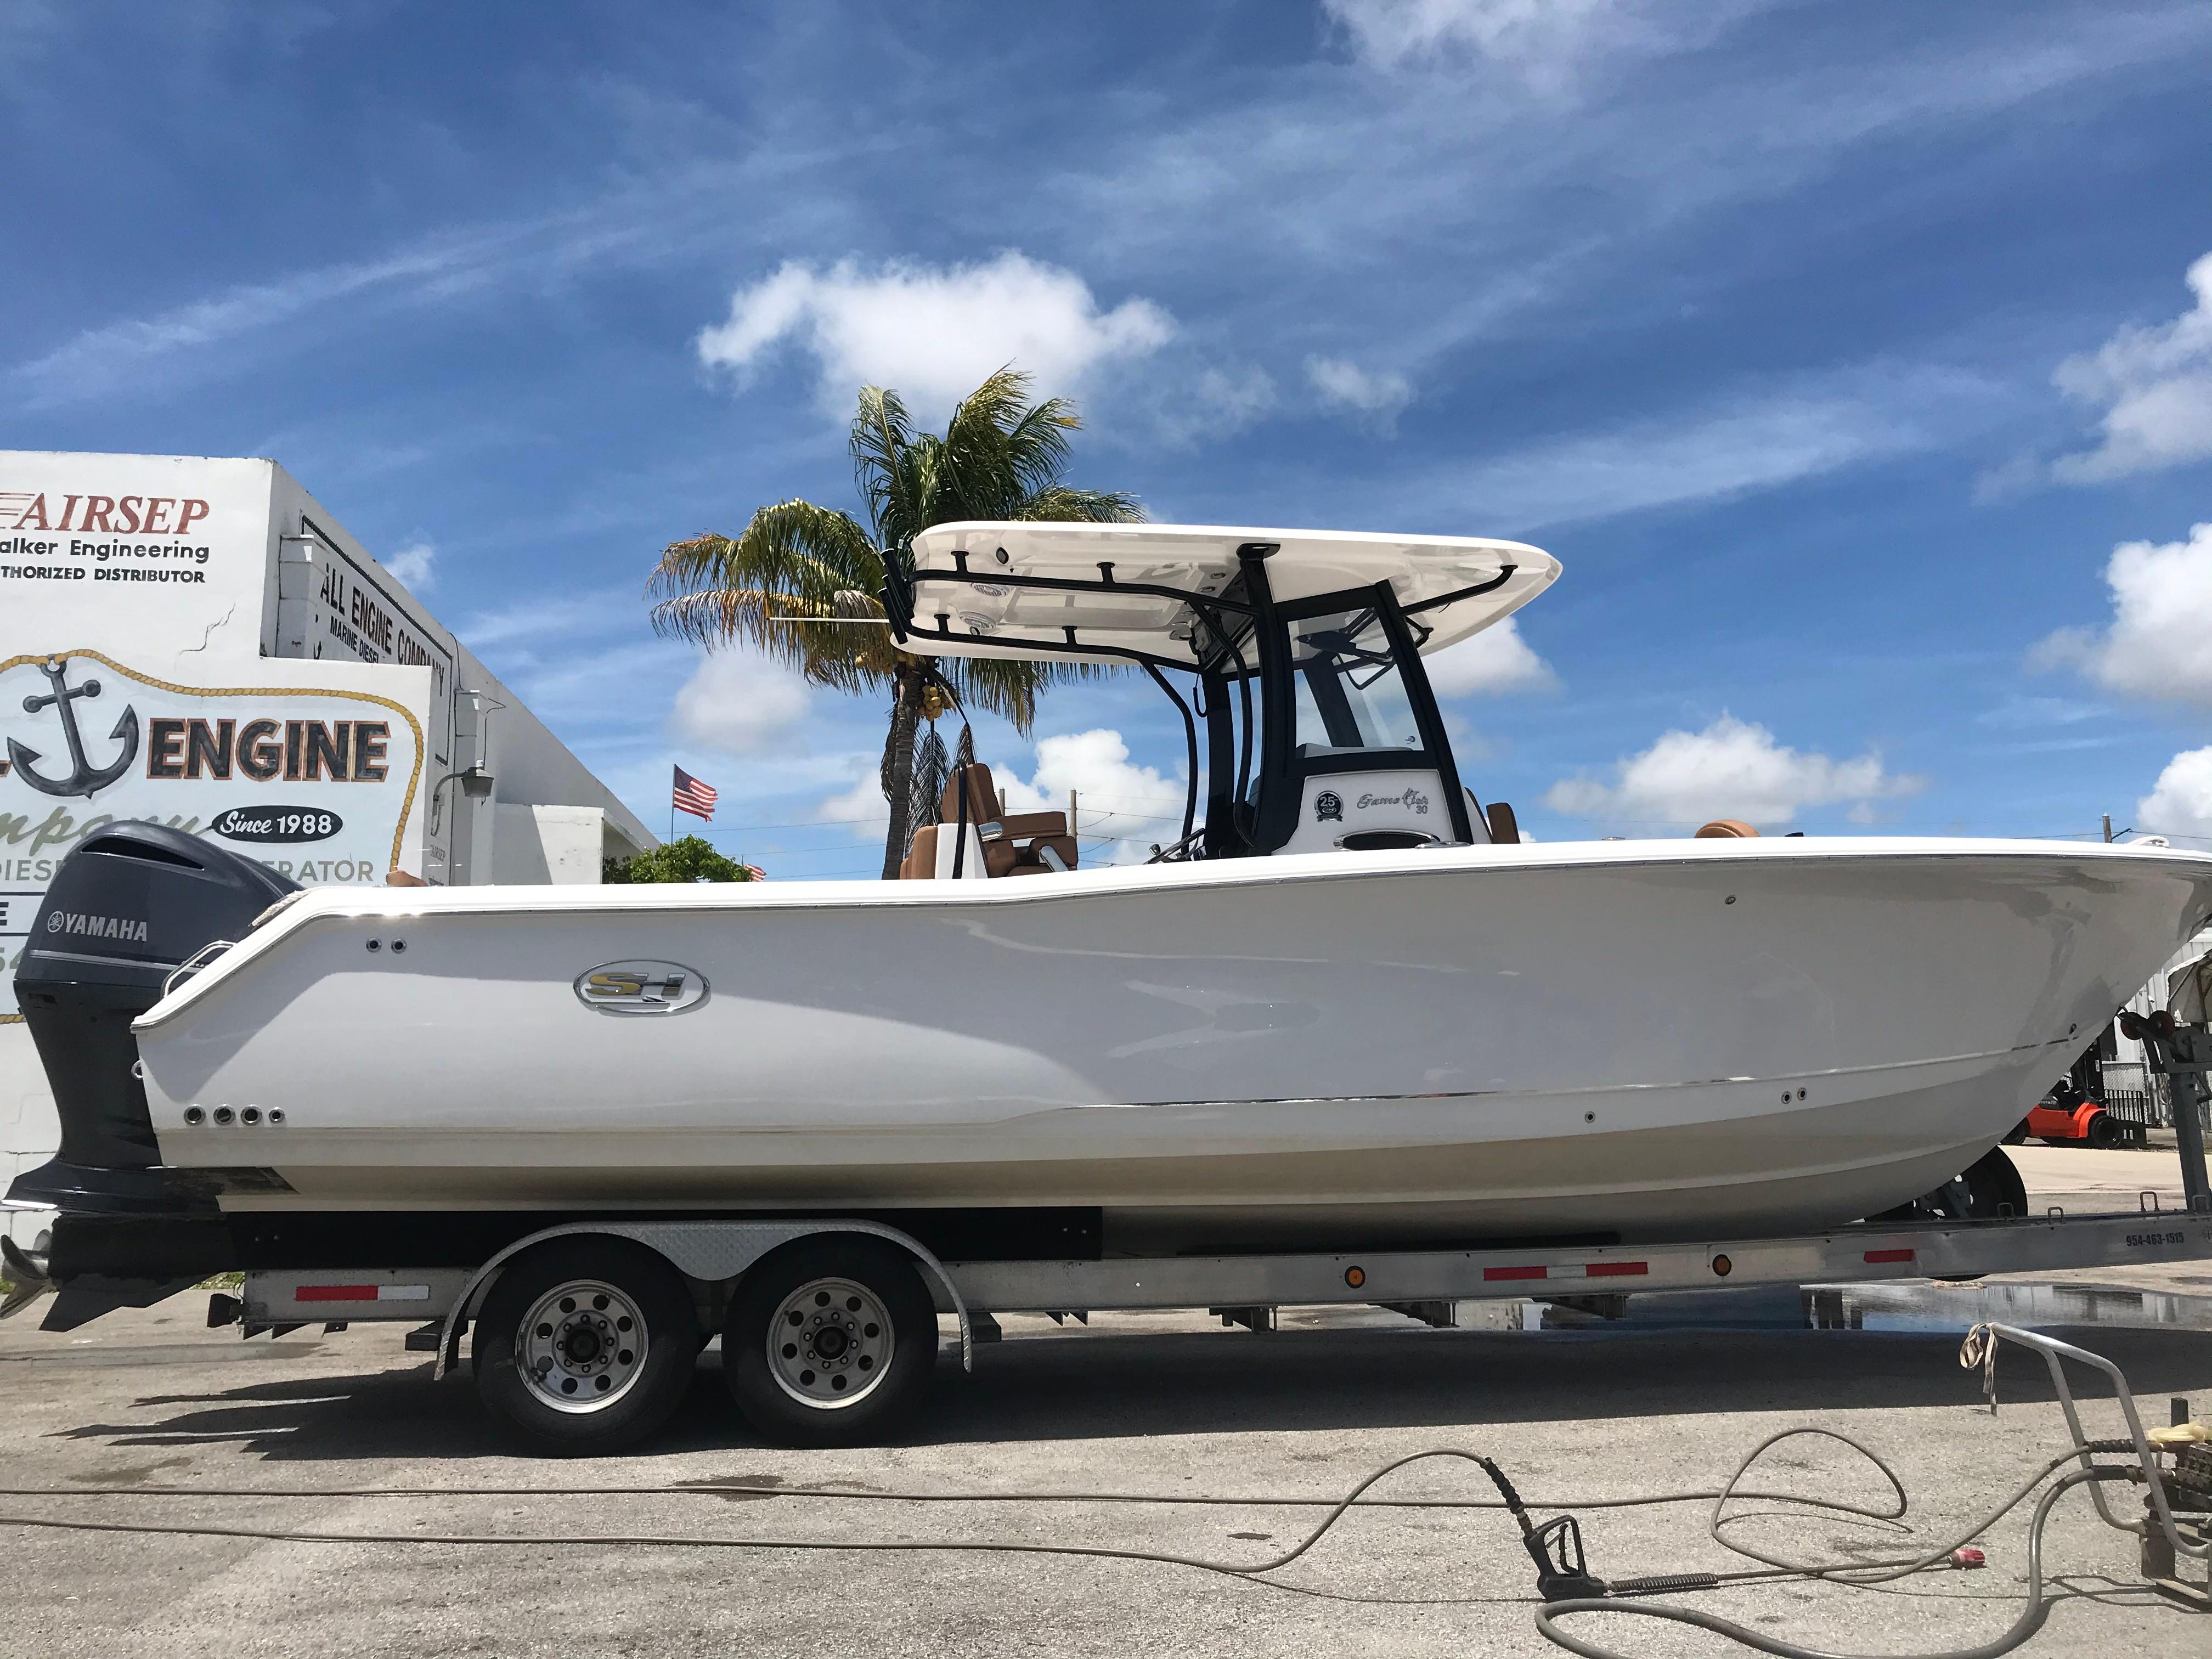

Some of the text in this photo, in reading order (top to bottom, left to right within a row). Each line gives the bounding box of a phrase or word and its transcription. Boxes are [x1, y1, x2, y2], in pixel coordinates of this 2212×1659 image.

[11, 493, 210, 534] AIRSEP
[70, 539, 209, 564] Engineering
[94, 568, 205, 583] DISTRIBUTOR
[320, 562, 345, 616] ALL
[351, 585, 393, 655] ENGINE
[330, 615, 358, 652] MARINE
[146, 718, 391, 783] ENGINE
[219, 811, 332, 834] Since 1988
[1415, 805, 1428, 814] 30
[66, 913, 148, 941] YAMAHA
